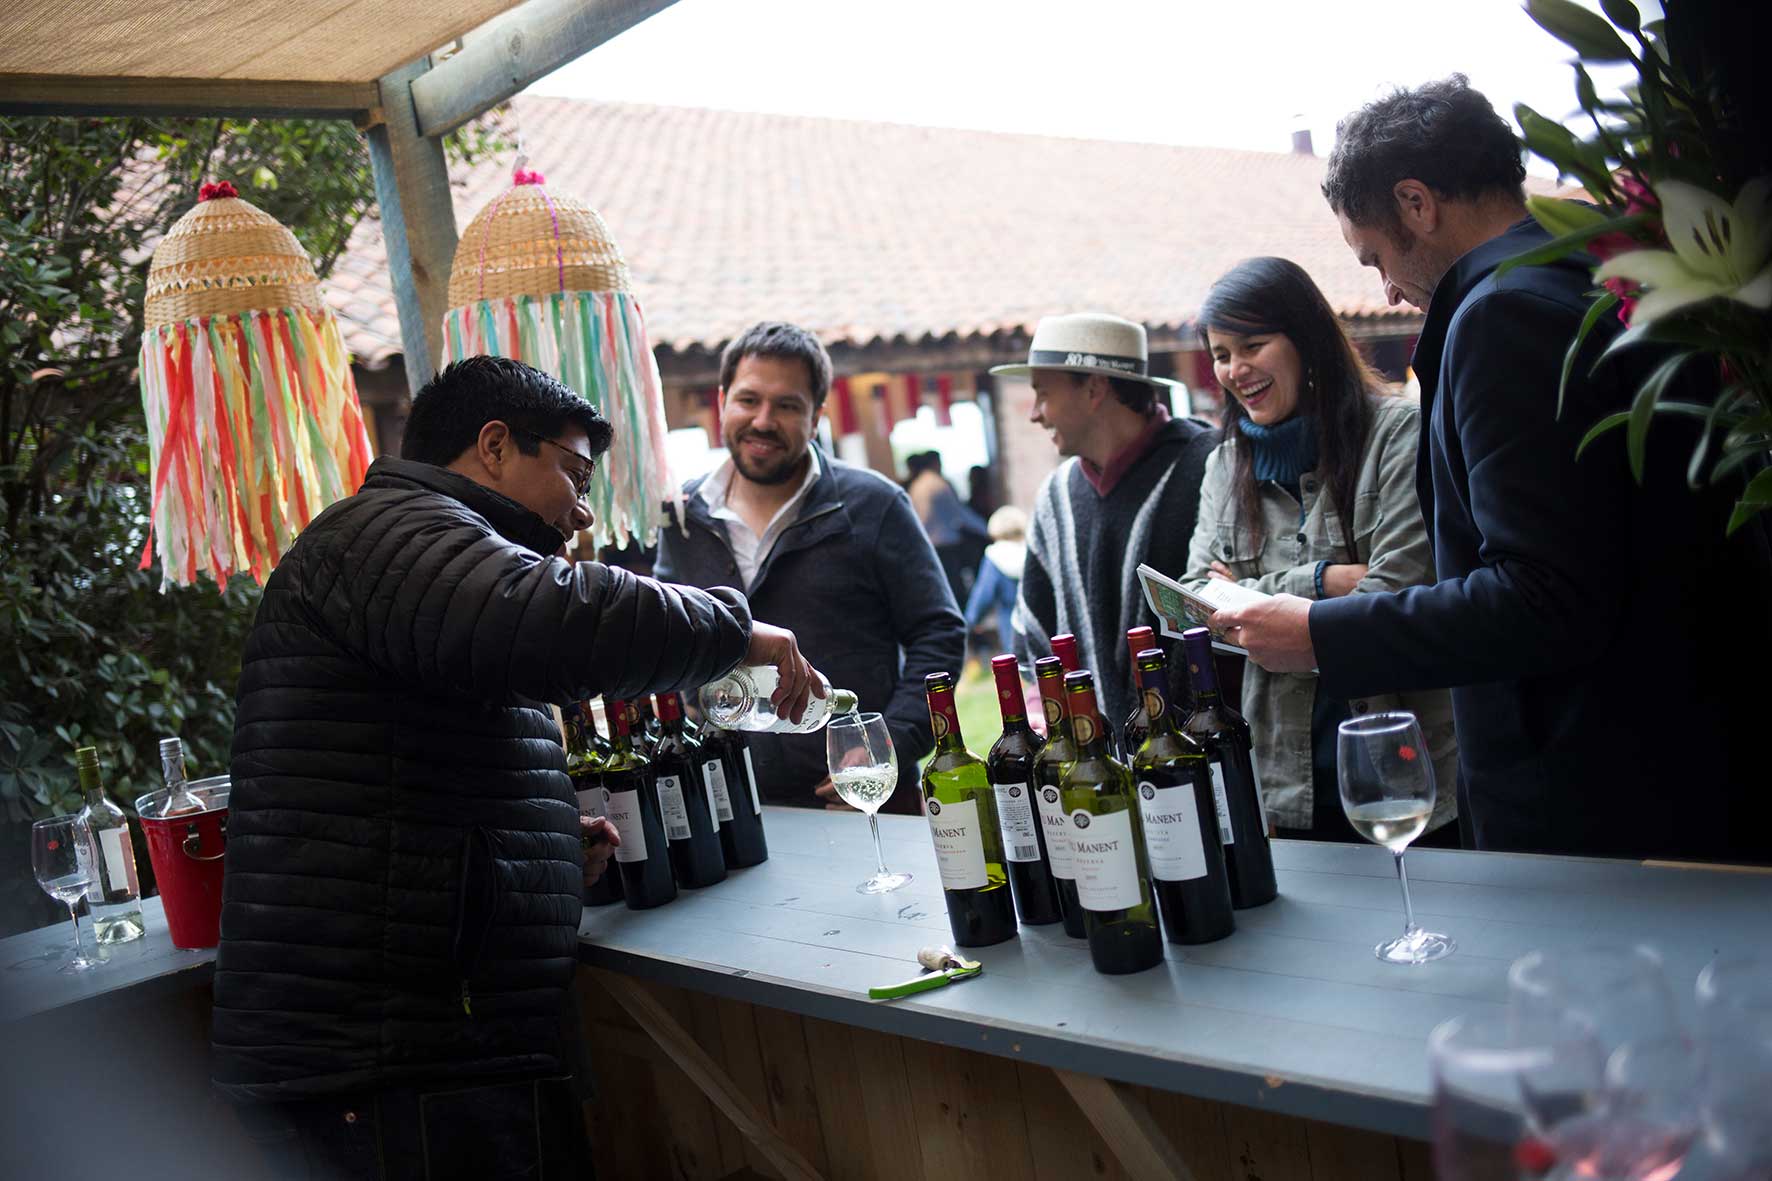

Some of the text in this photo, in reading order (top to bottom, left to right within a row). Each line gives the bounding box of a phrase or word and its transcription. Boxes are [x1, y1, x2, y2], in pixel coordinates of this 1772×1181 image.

[1046, 815, 1065, 826] MAN
[1145, 812, 1183, 825] MANENT
[932, 827, 966, 838] MANENT
[1077, 840, 1119, 854] MANENT
